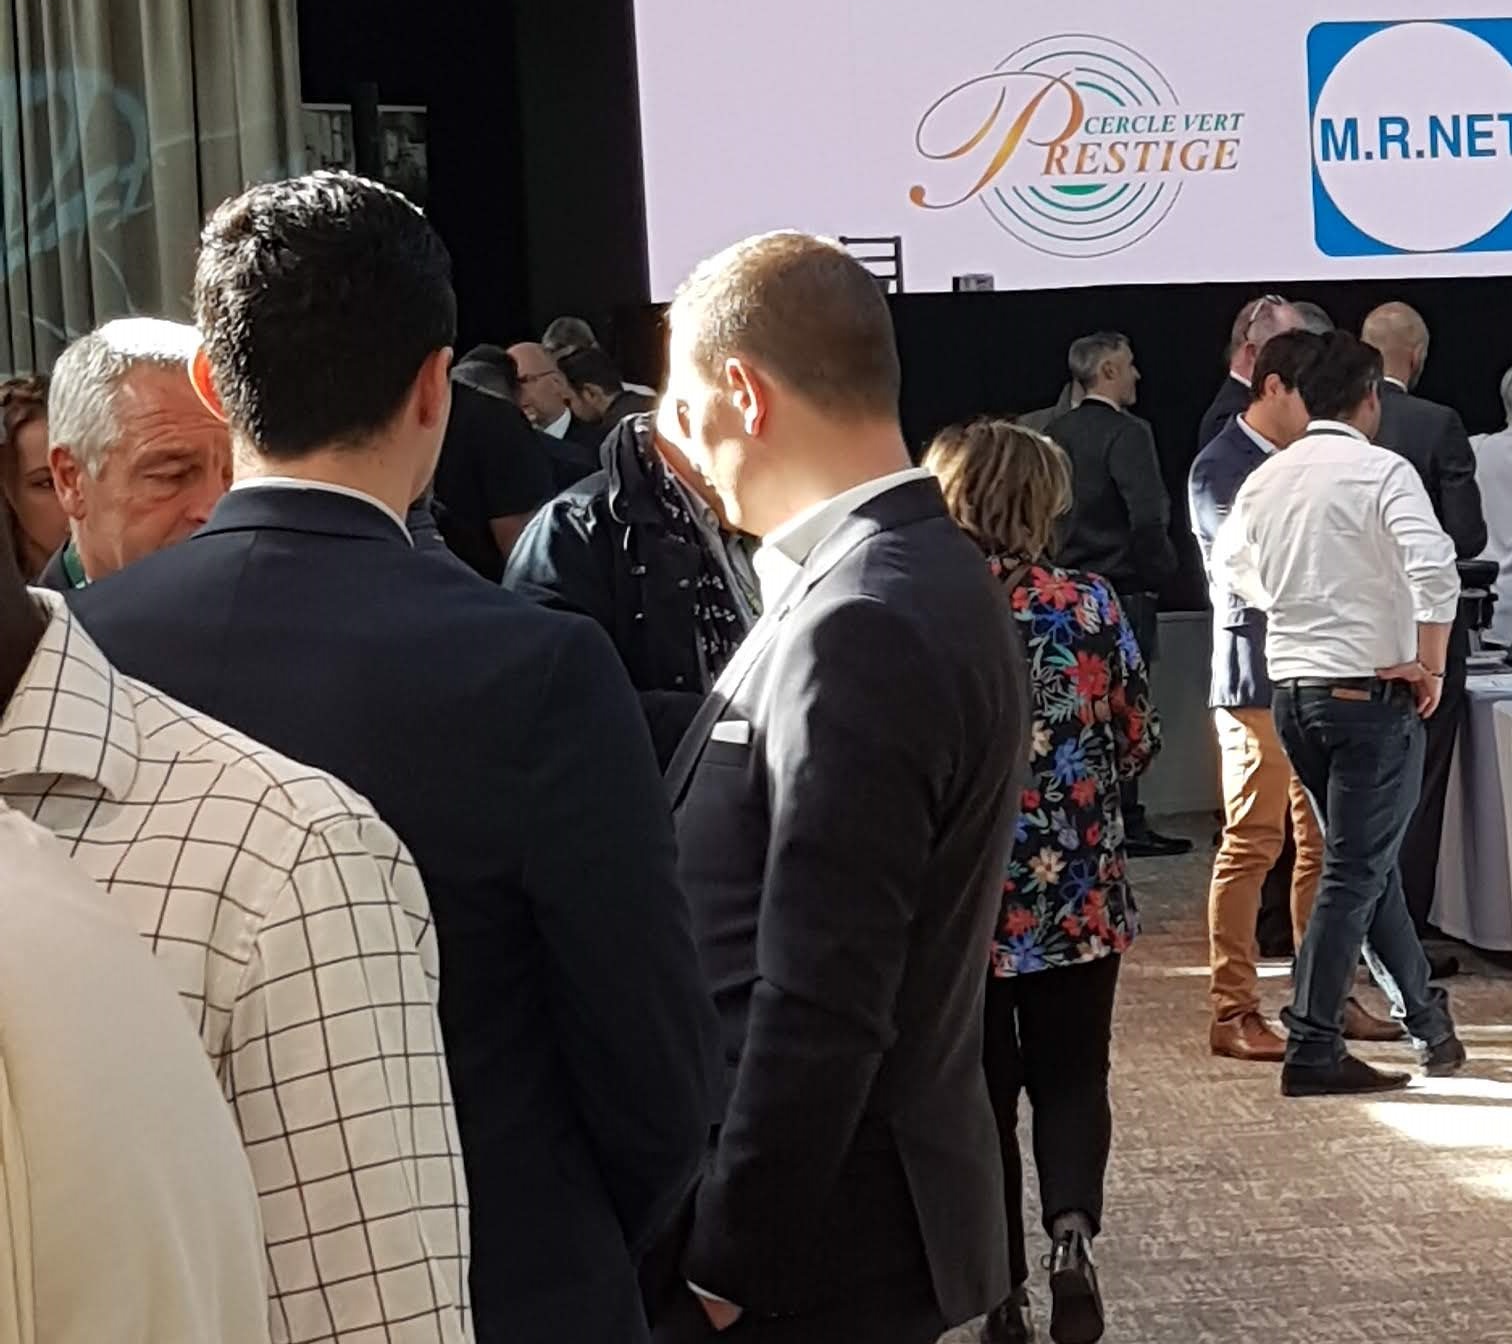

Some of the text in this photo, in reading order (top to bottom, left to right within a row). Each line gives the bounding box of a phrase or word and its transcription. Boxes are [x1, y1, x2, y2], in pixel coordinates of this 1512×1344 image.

[909, 71, 1241, 209] PRESTIGE
[1084, 113, 1246, 135] CERCLE VERT
